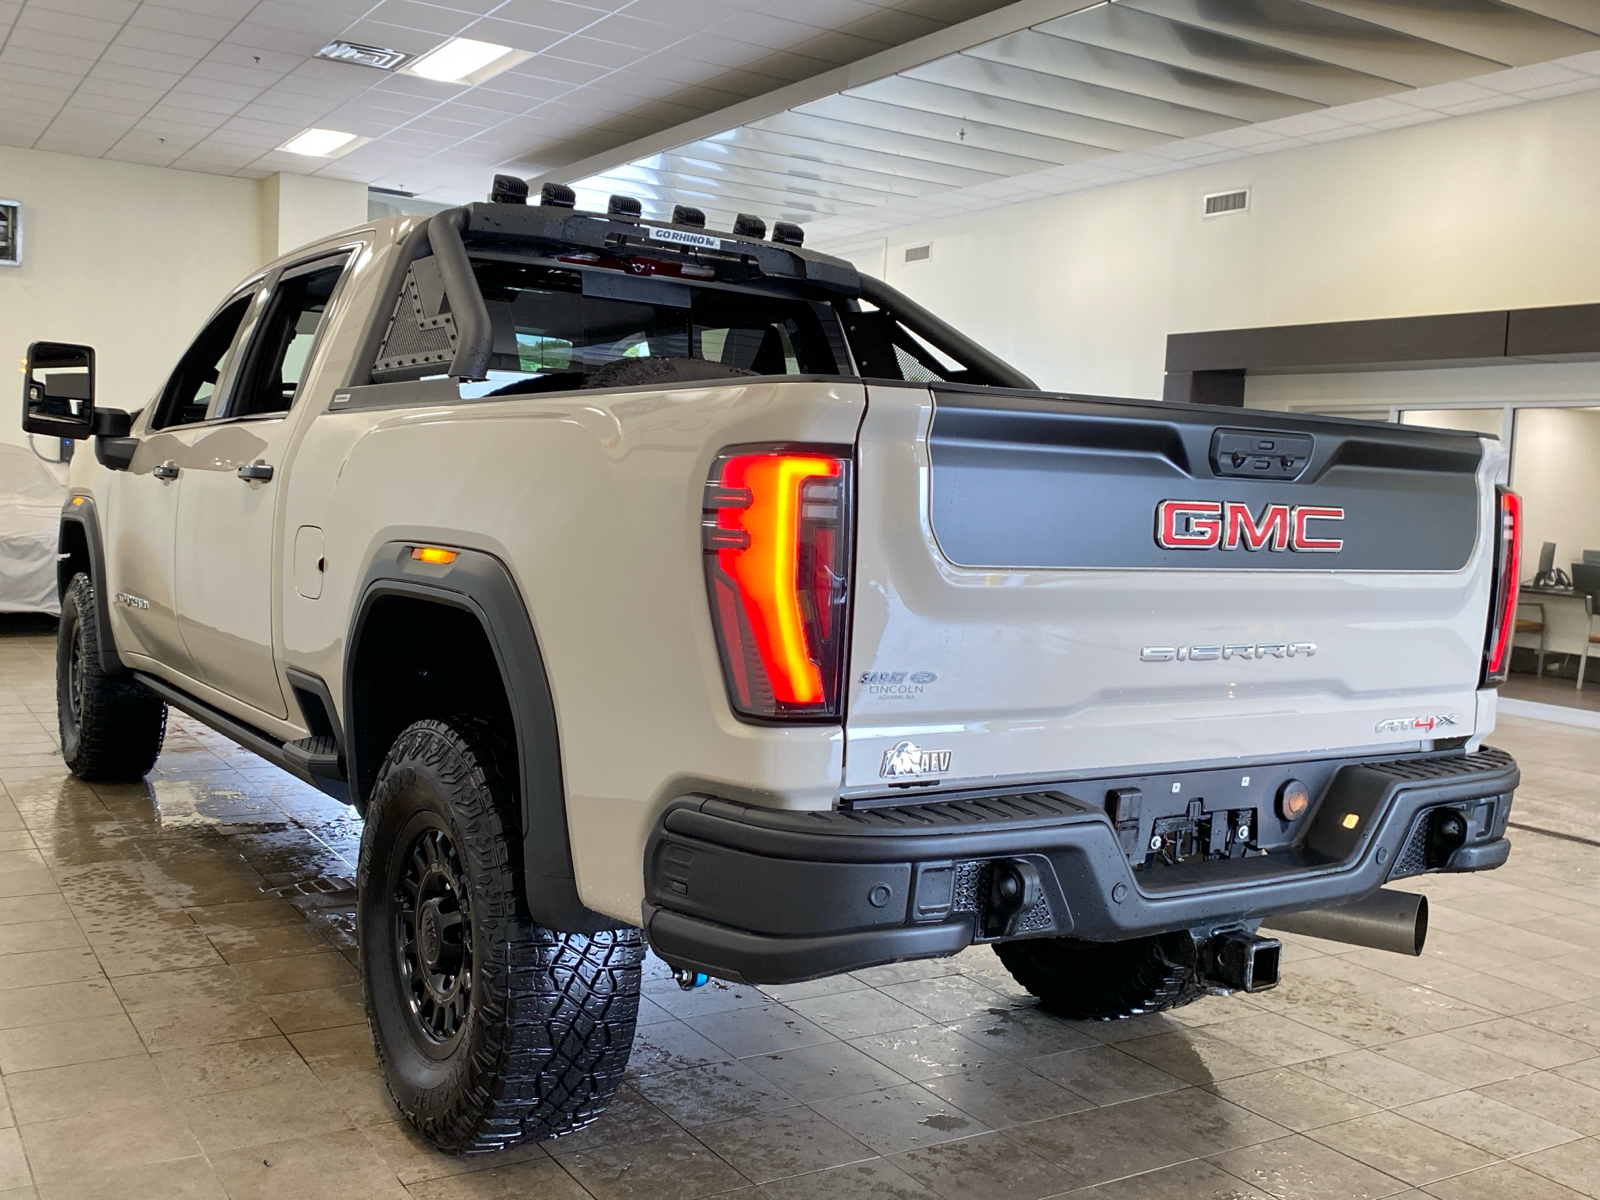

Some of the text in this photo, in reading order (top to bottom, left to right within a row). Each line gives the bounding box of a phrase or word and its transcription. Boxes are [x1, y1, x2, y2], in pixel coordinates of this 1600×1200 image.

[1154, 499, 1345, 553] GMC
[1140, 642, 1317, 662] SIERRA
[869, 685, 924, 694] LINCOLN
[1374, 714, 1458, 733] AT4X
[920, 751, 951, 773] AEV
